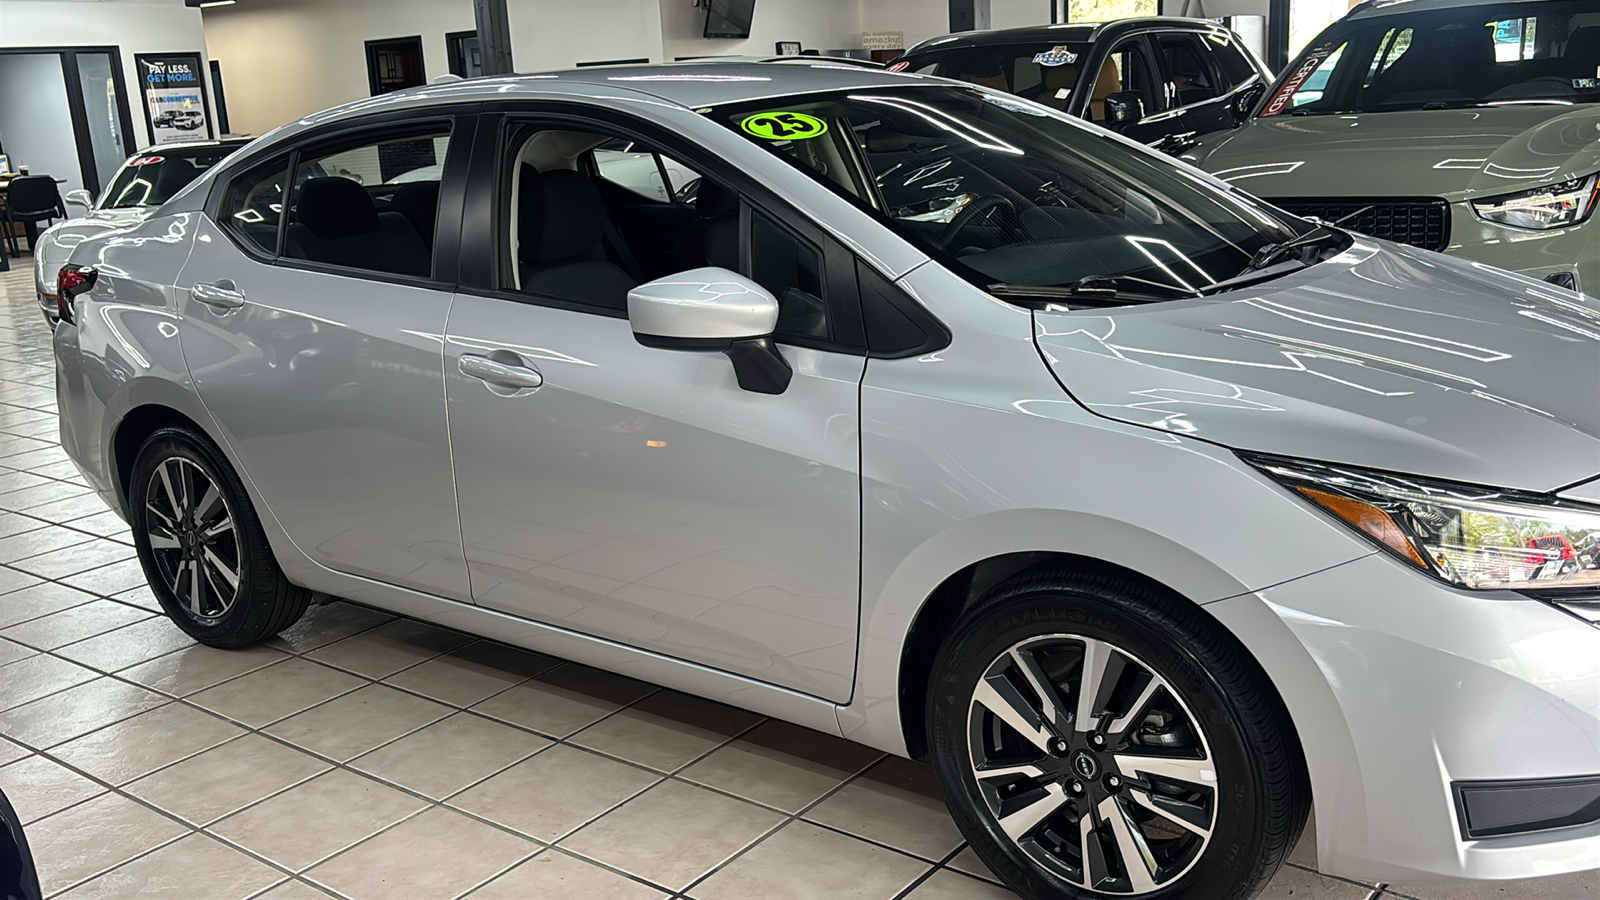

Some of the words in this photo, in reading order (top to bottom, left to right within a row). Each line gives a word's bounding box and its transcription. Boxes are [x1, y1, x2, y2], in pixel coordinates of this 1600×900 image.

[864, 36, 902, 44] amazing
[149, 65, 166, 74] PAY
[168, 64, 192, 73] LESS.
[147, 74, 165, 83] GET
[167, 73, 196, 82] MORE.
[1268, 58, 1319, 112] CERTIFIED
[754, 113, 814, 137] 25
